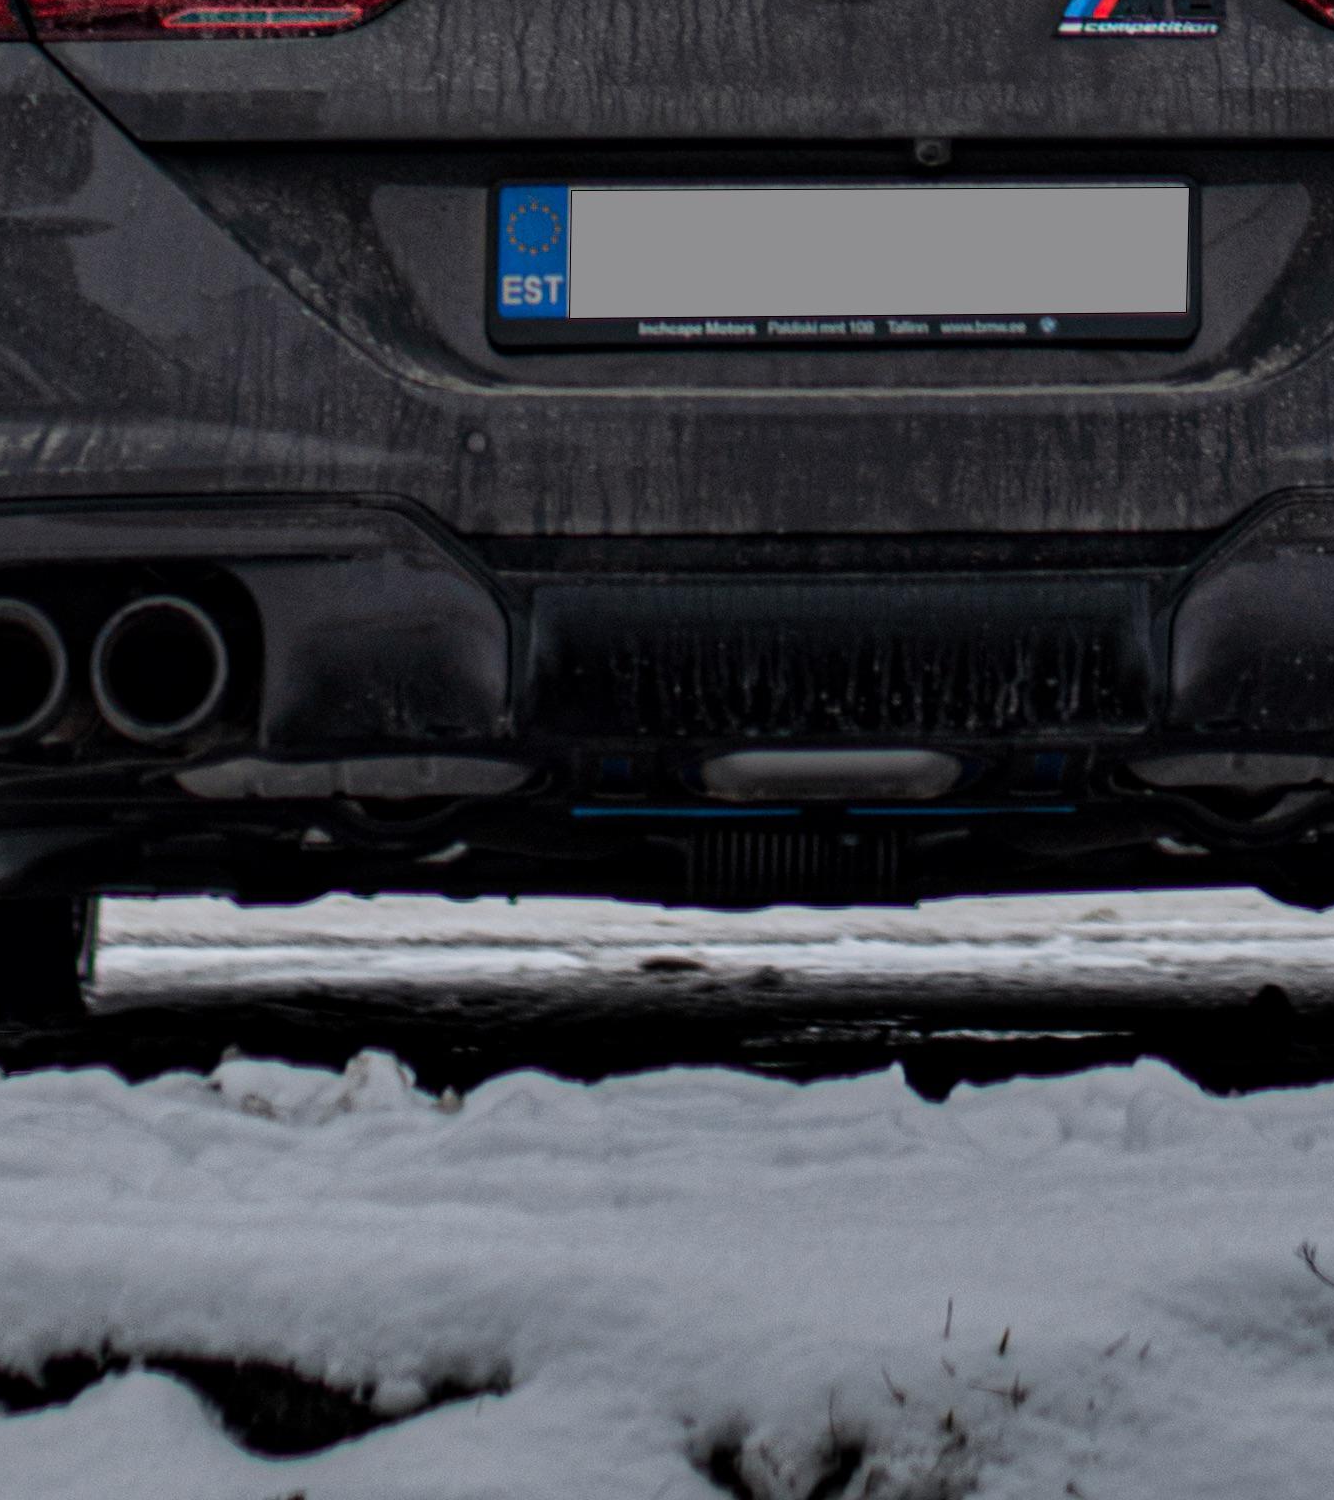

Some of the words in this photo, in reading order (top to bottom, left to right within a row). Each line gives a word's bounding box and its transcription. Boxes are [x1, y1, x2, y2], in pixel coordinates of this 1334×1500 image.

[1083, 22, 1218, 35] competition
[502, 274, 563, 305] EST
[638, 322, 703, 338] Inchcape
[705, 320, 757, 336] Motors
